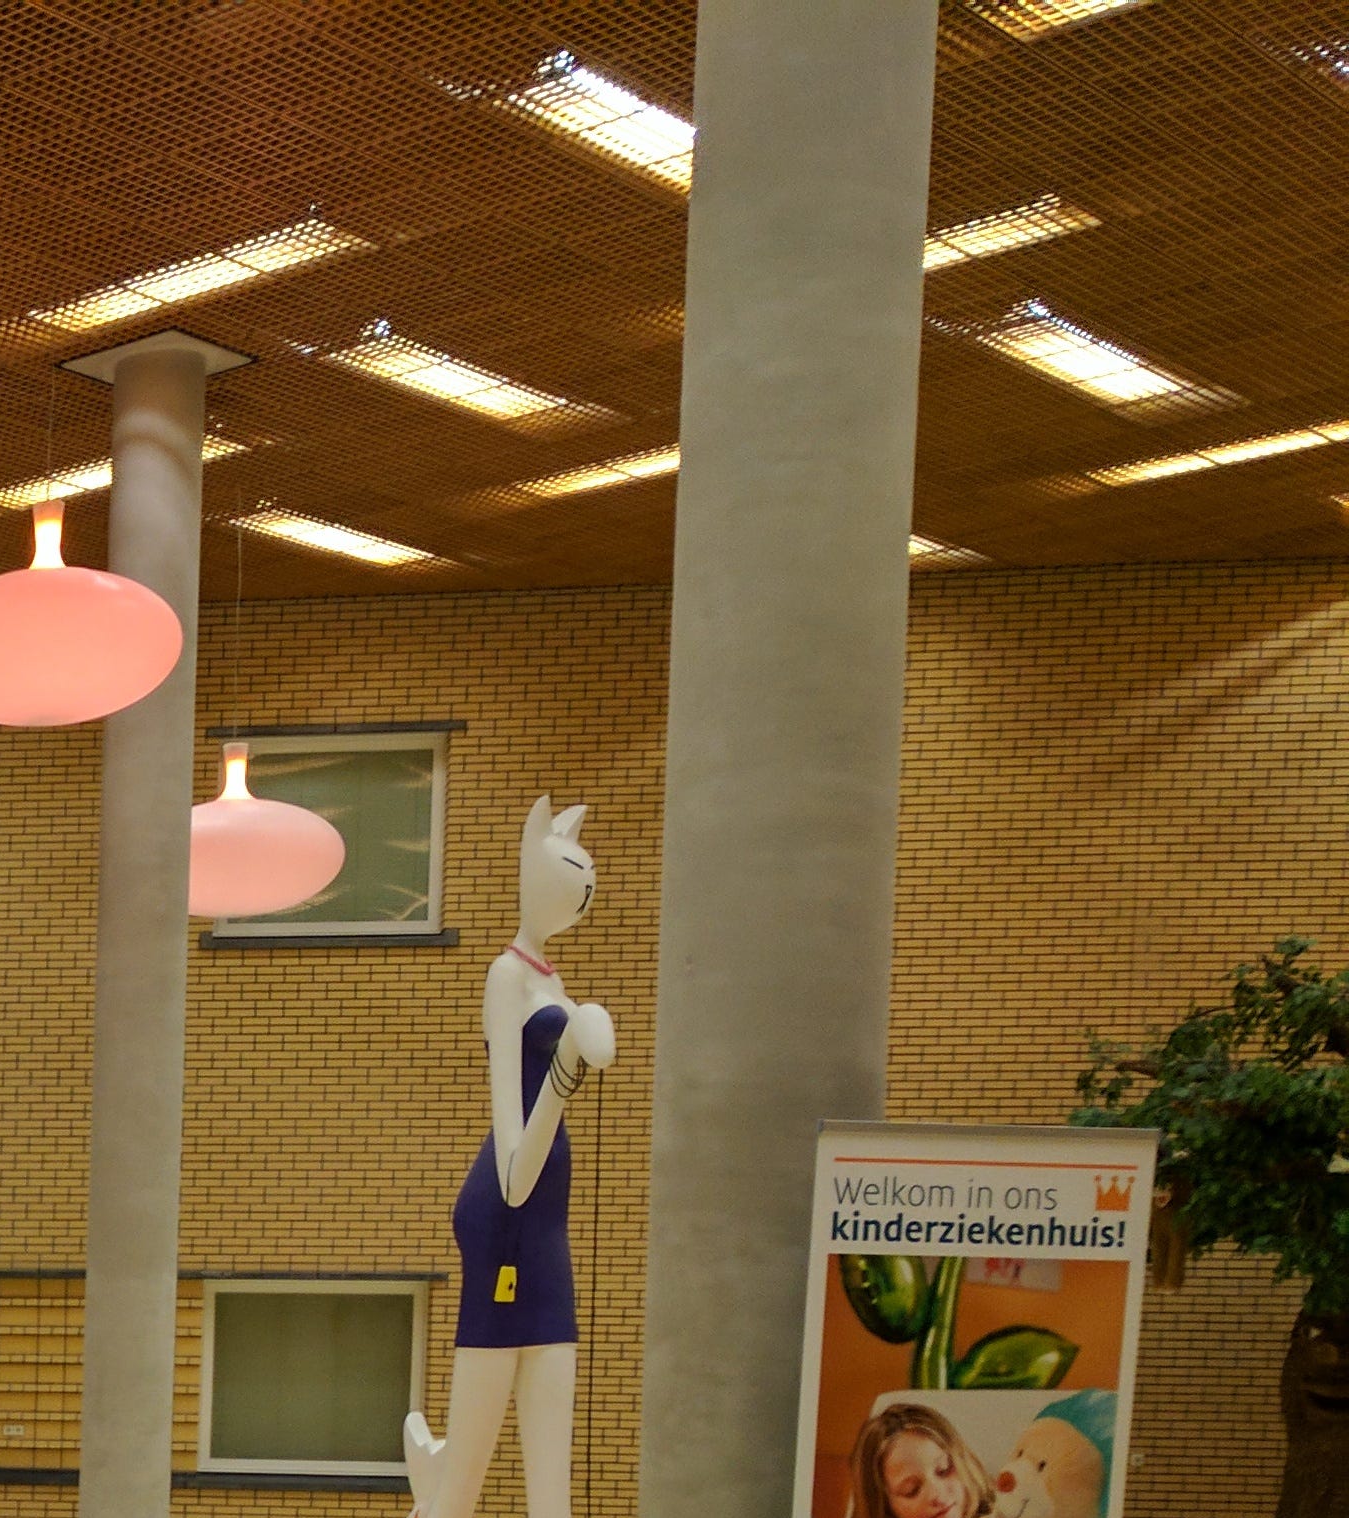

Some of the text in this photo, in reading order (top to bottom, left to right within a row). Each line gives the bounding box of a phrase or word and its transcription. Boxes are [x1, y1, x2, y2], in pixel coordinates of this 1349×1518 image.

[833, 1176, 1058, 1211] Welkom in ons
[831, 1211, 1127, 1249] kinderziekenhuis!
